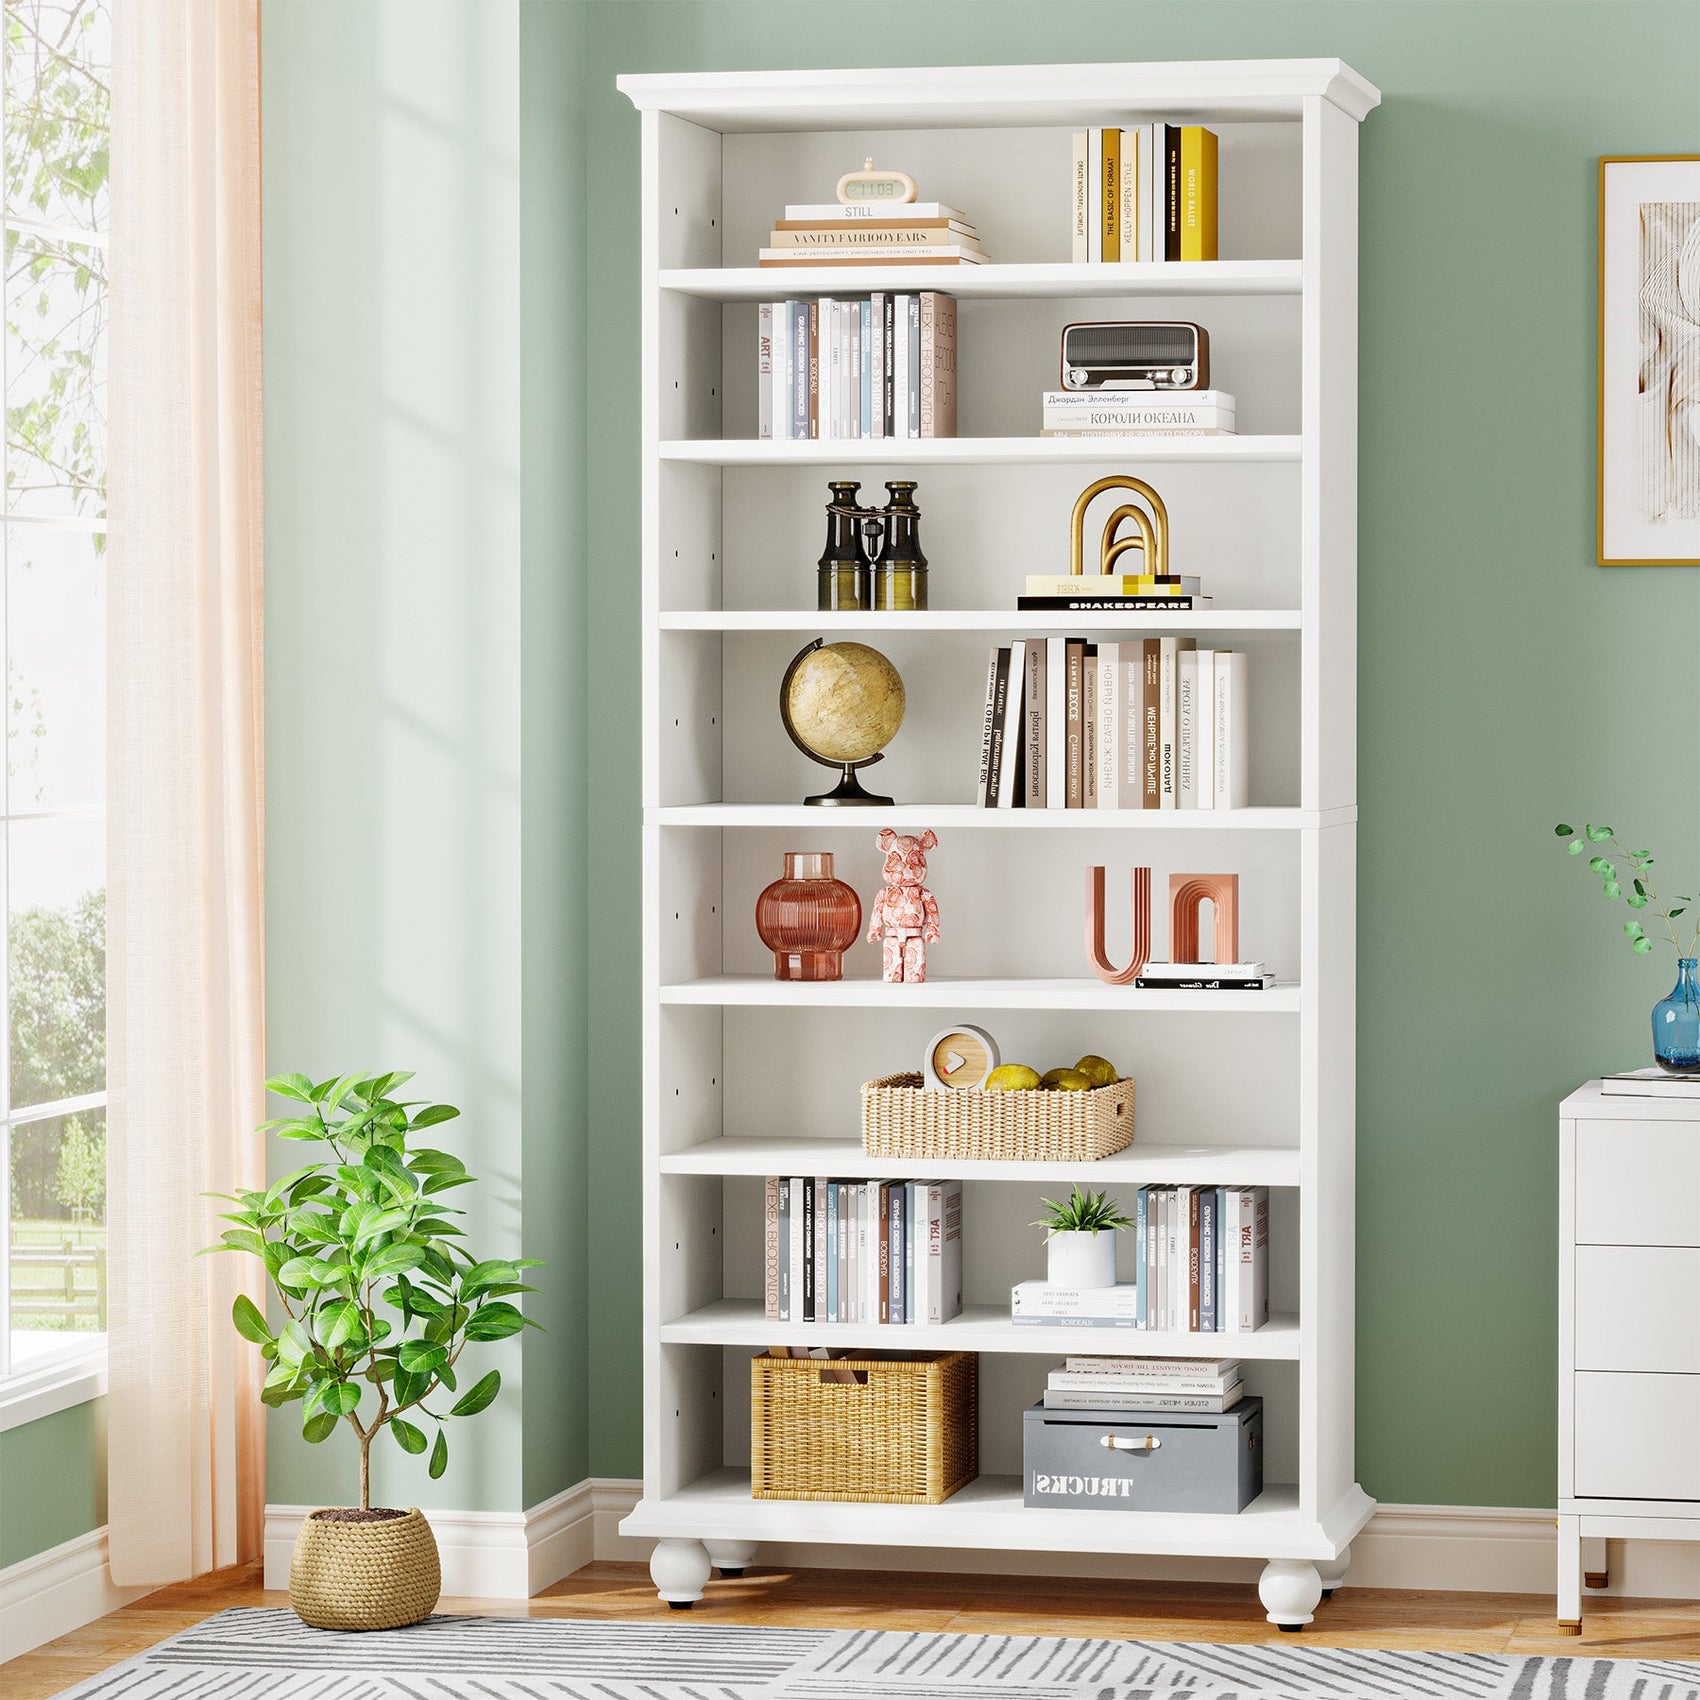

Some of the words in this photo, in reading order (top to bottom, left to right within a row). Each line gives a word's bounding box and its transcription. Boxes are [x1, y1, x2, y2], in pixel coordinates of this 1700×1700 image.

[1124, 162, 1132, 185] STYLE
[1187, 169, 1195, 197] WORLD
[1107, 189, 1114, 199] OF
[1124, 187, 1132, 218] HOPPEN
[845, 206, 873, 217] STILL
[1187, 199, 1195, 227] BALLET
[1124, 220, 1132, 243] KELLY
[921, 296, 933, 344] ALEXEY
[761, 336, 770, 358] ART
[873, 328, 882, 358] BOOK
[810, 358, 818, 394] BORDEAUX
[873, 369, 882, 422] SYMBOLS
[921, 349, 933, 432] BRODOVITCH
[1048, 395, 1085, 404] Джордан
[1087, 394, 1130, 404] Элленберг
[1091, 412, 1141, 424] КОРОЛИ
[1144, 412, 1195, 424] ОКЕАНА
